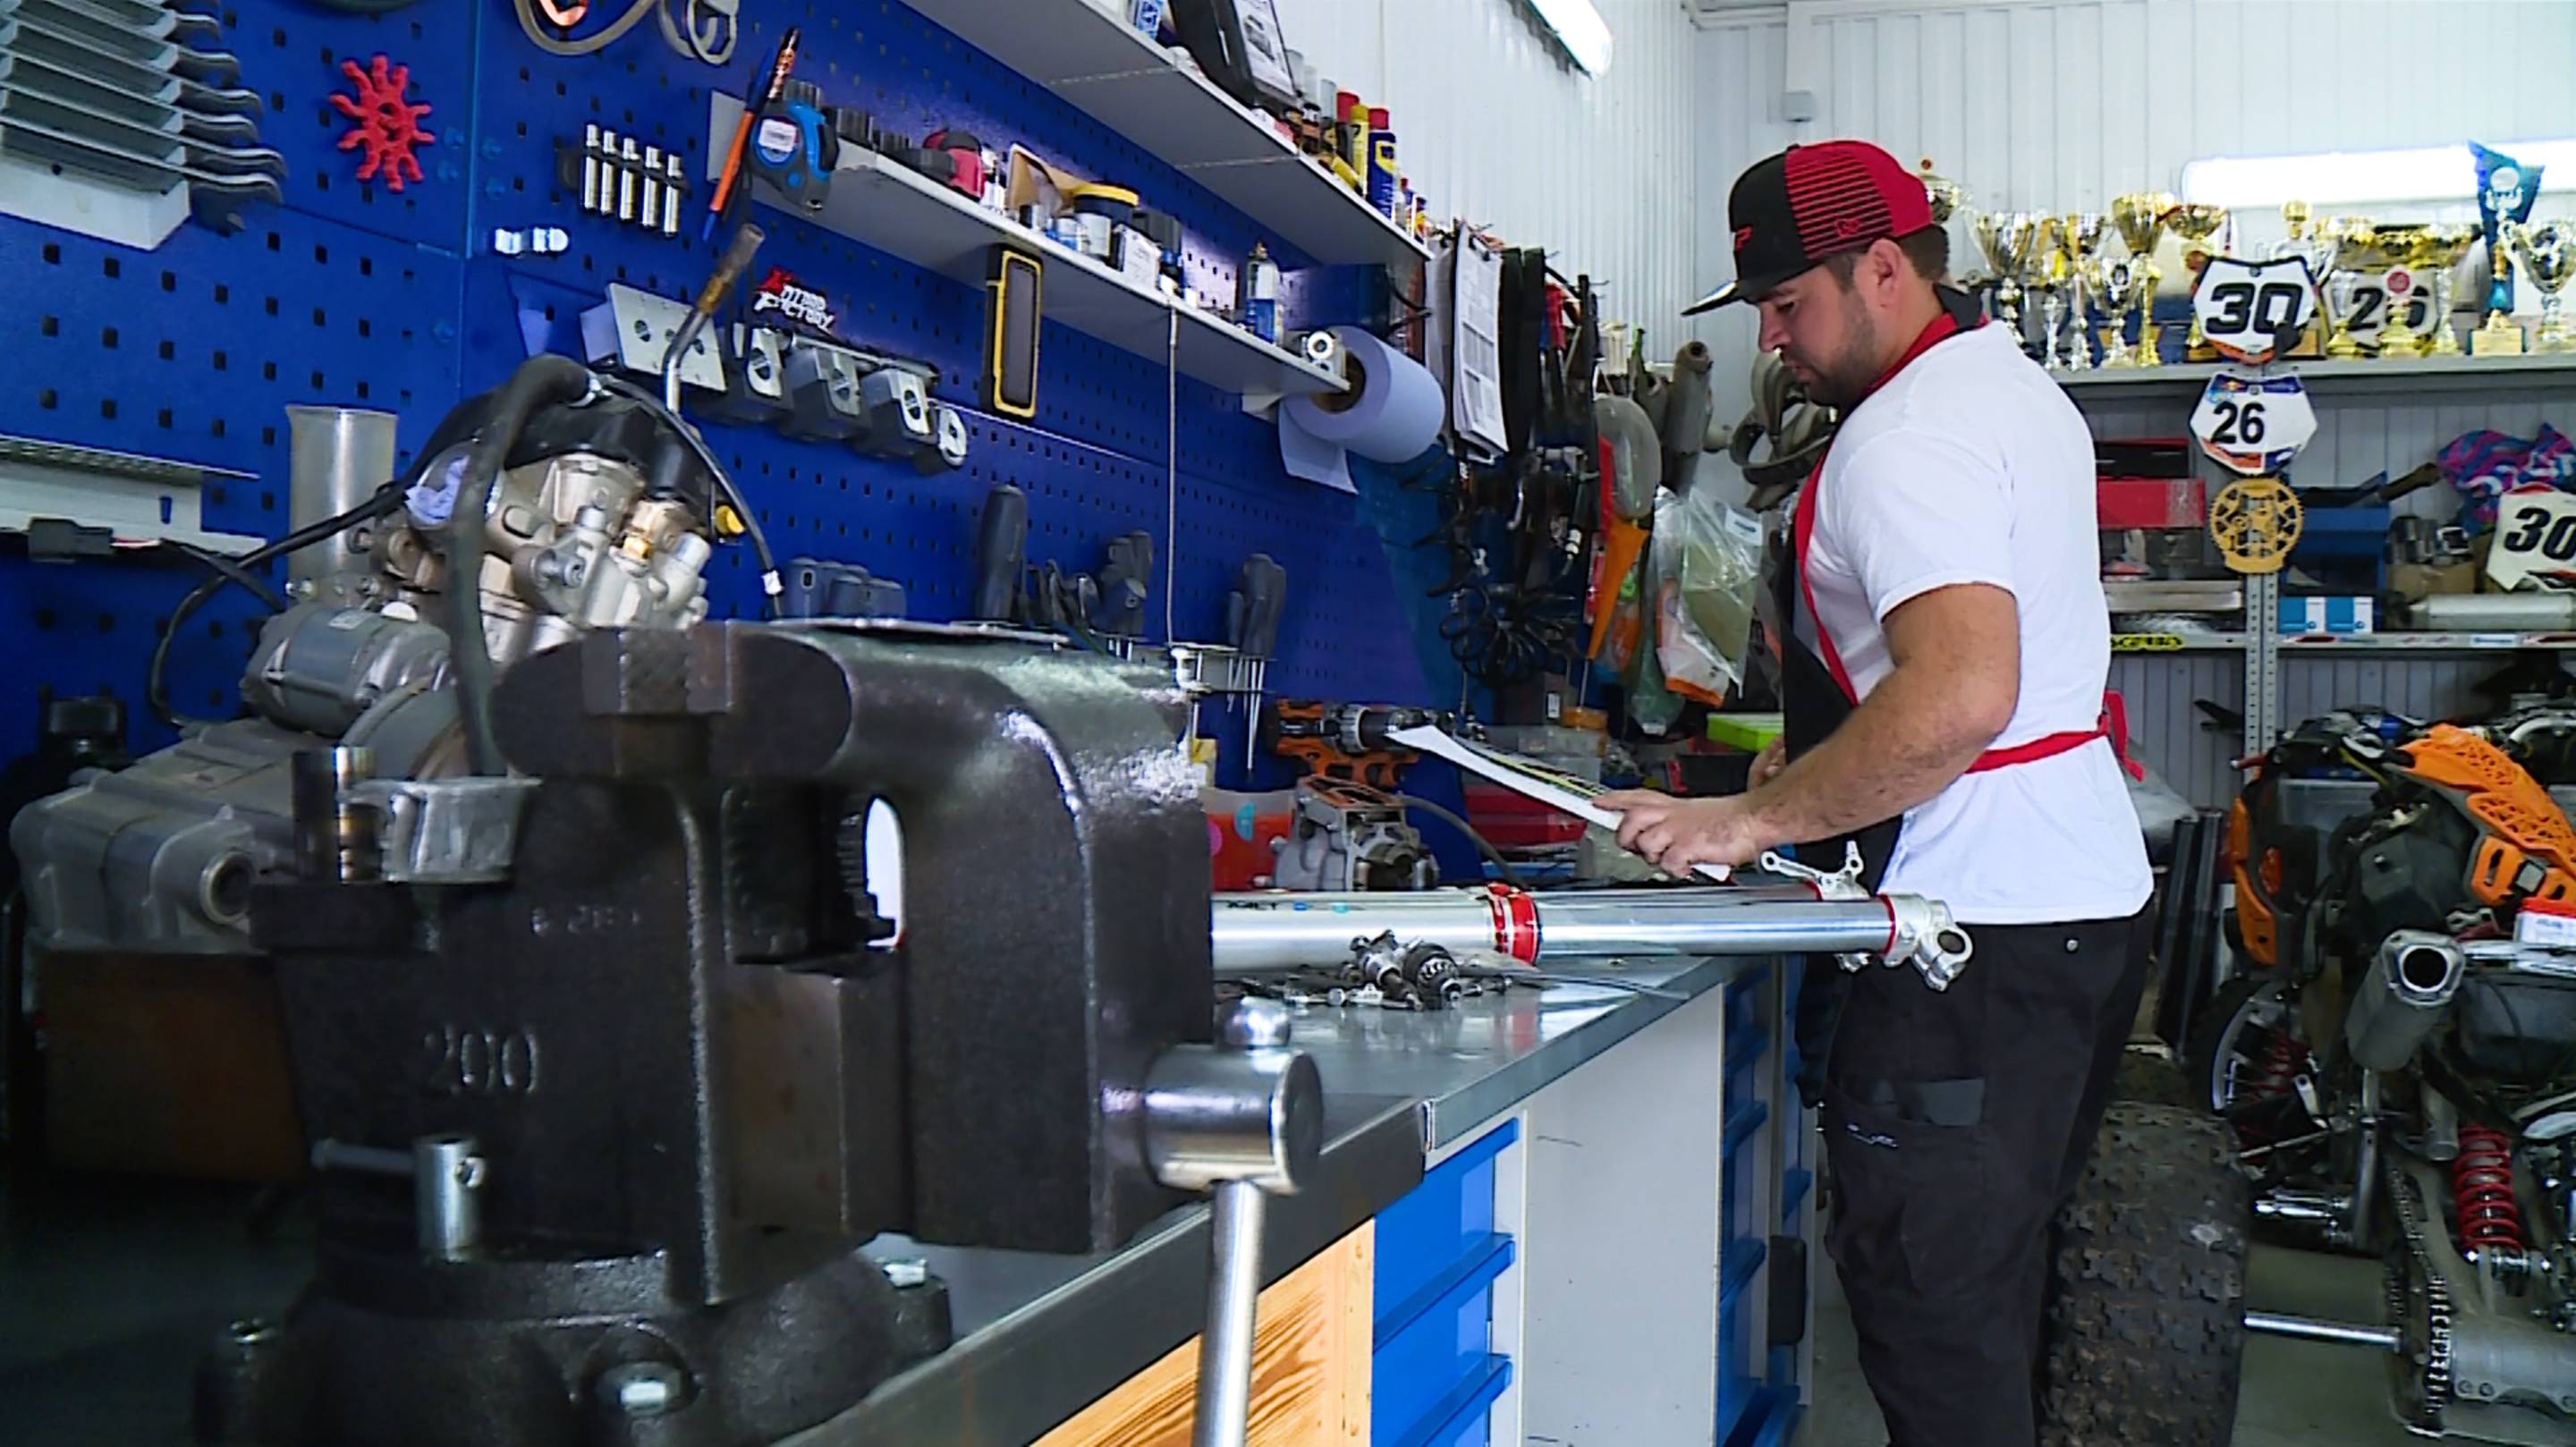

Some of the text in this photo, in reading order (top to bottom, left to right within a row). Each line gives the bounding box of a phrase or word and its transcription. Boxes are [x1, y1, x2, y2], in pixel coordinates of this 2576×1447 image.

[2205, 283, 2303, 334] 30
[2211, 401, 2266, 444] 26
[2504, 506, 2576, 561] 30
[423, 1023, 540, 1094] 200
